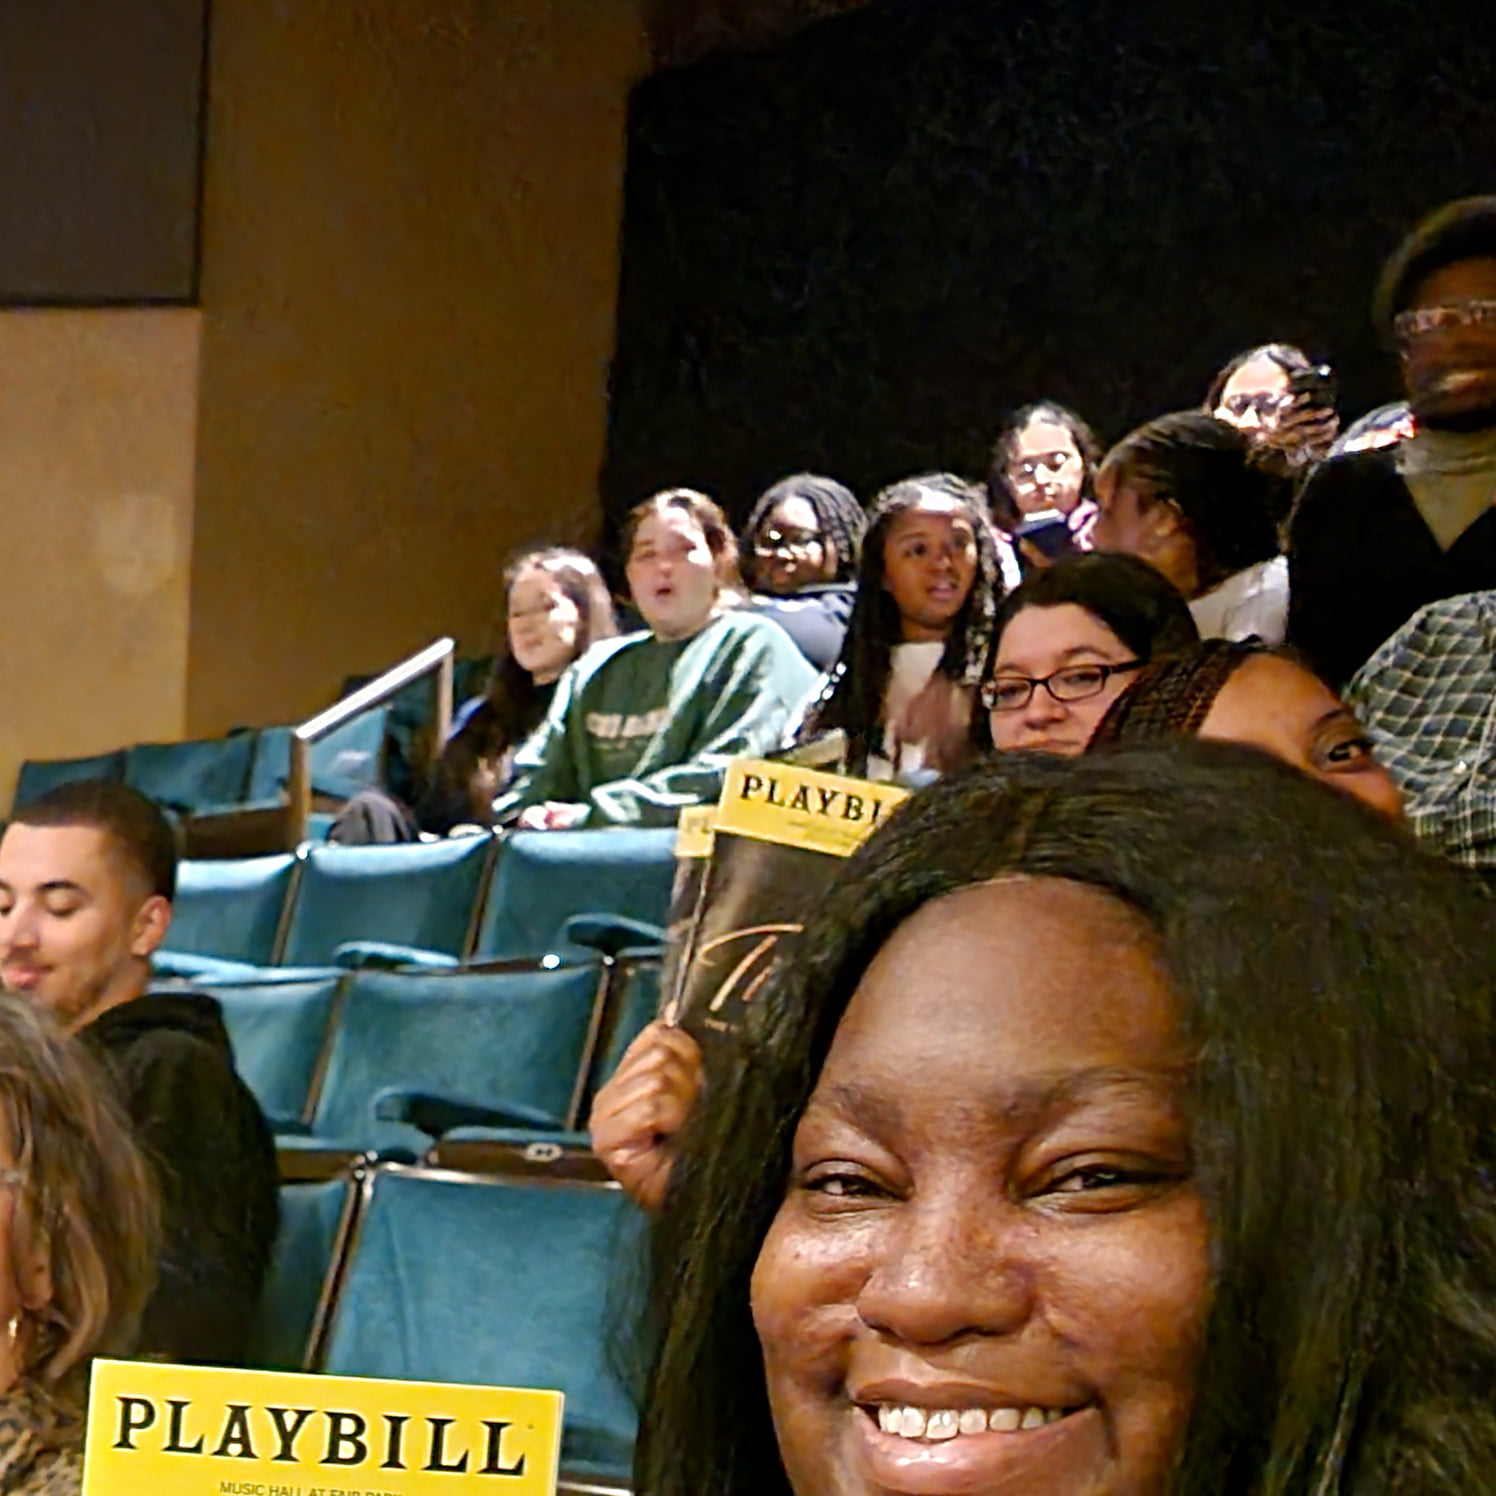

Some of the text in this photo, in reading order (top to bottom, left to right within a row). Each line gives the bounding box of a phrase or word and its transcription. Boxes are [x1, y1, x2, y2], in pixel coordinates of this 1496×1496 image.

[740, 774, 883, 825] PLAYBI
[110, 1396, 527, 1478] PLAYBILL
[219, 1481, 265, 1496] MUSIC
